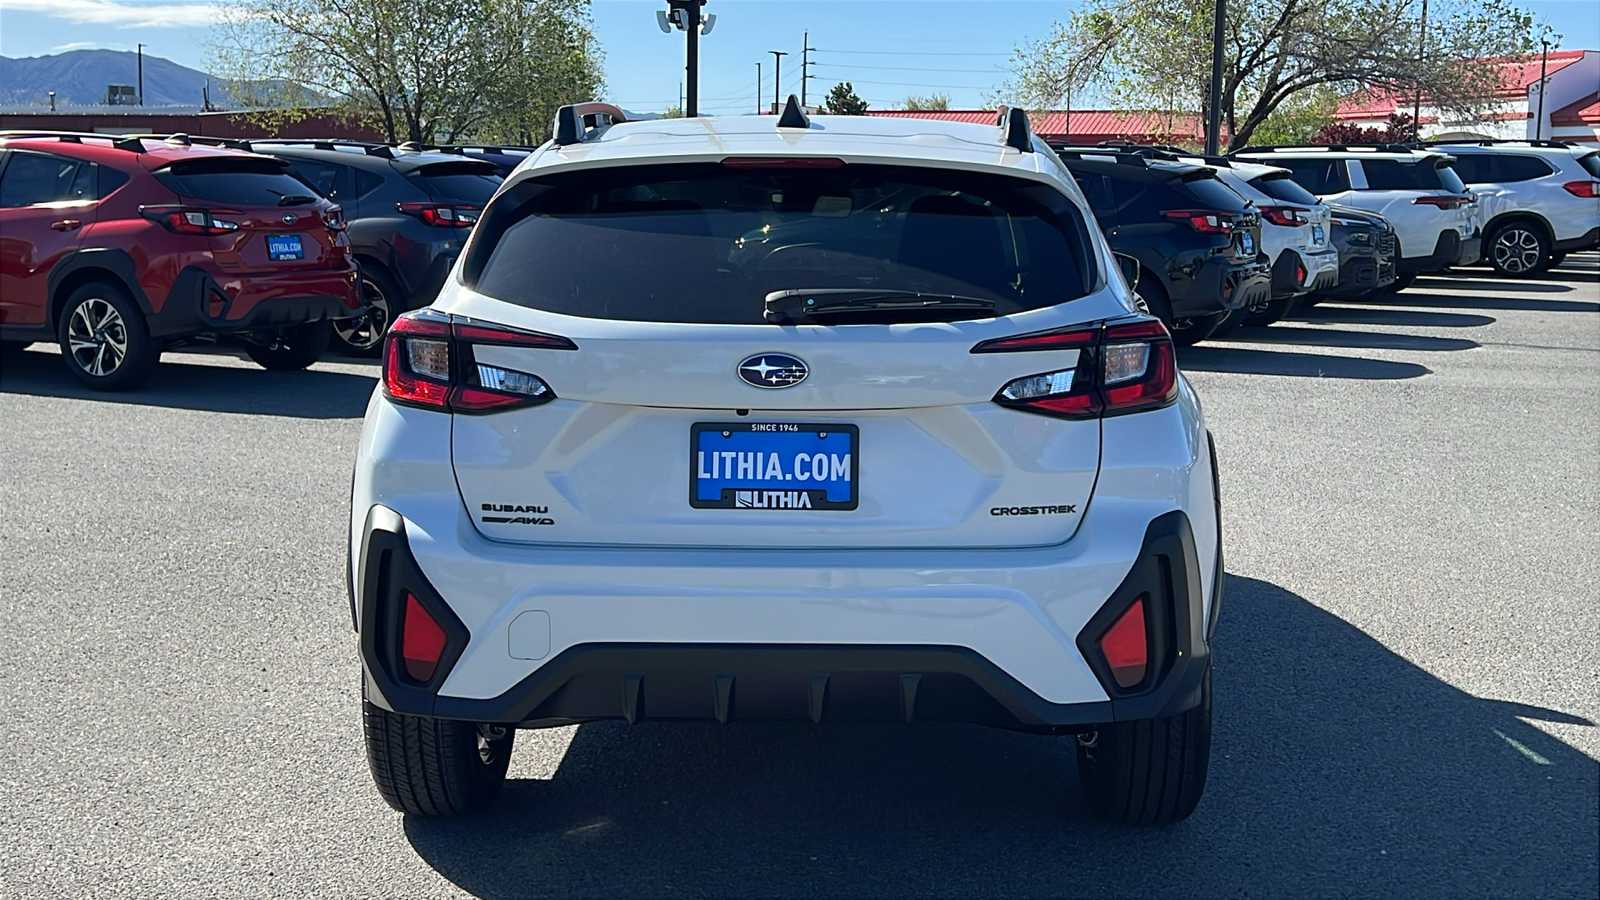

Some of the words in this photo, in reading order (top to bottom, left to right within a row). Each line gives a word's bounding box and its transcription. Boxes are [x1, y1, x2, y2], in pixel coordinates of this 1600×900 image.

[269, 243, 302, 253] LITHIA.COM
[751, 424, 777, 432] SINCE
[779, 424, 799, 432] 1946
[698, 451, 851, 482] LITHIA.COM
[752, 491, 812, 509] LITHIA
[481, 503, 549, 514] SUBARU
[990, 504, 1077, 516] CROSSTREK
[508, 517, 555, 525] AWD
